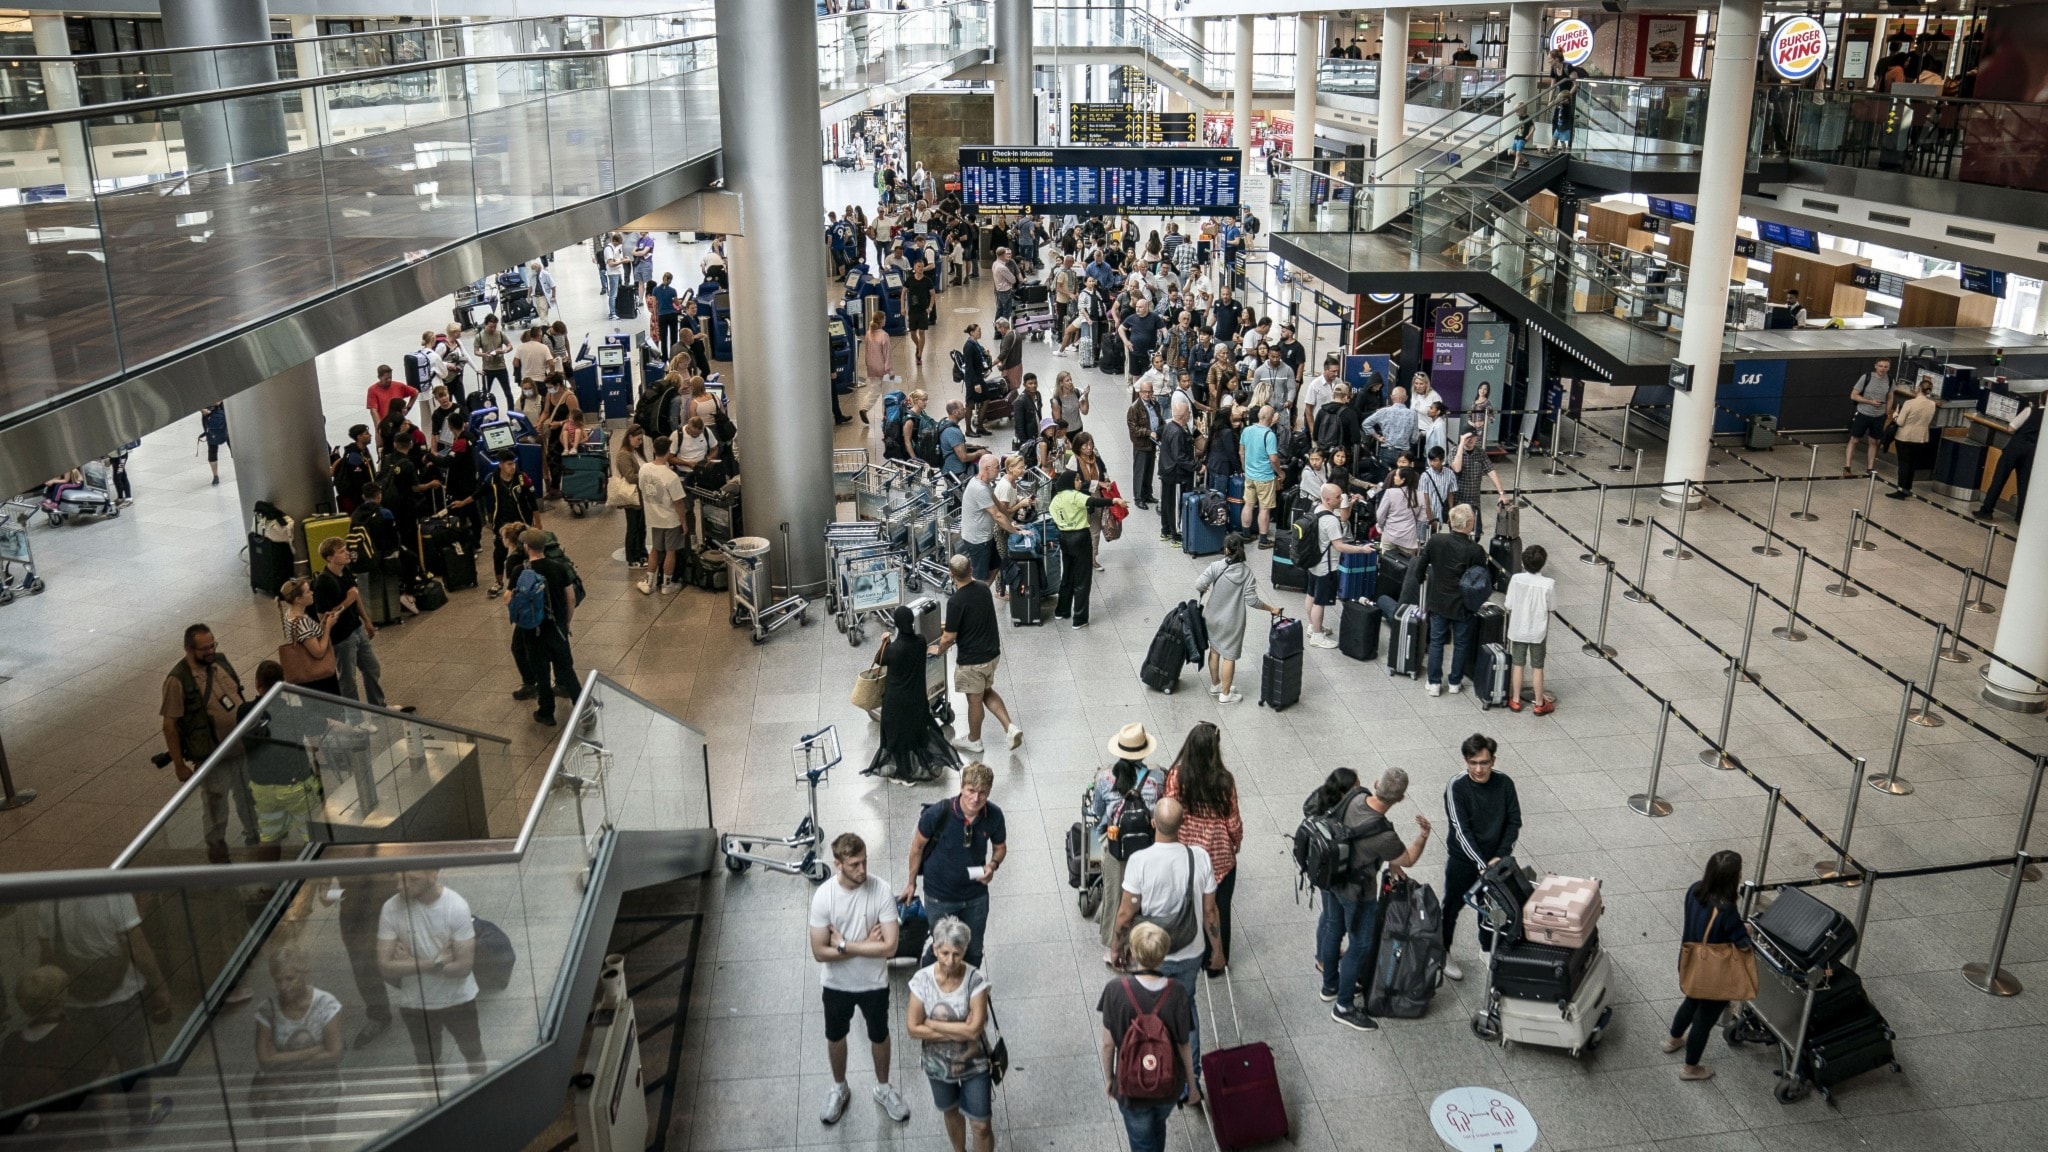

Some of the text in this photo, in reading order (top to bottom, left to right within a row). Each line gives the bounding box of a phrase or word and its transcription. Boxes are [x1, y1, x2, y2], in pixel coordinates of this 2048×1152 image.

[1556, 29, 1588, 44] BURGER
[1558, 36, 1589, 52] KING
[1779, 29, 1820, 50] BURGER
[1779, 40, 1821, 65] KING
[1024, 205, 1032, 214] 3
[837, 228, 844, 239] 9
[1738, 373, 1763, 385] SAS
